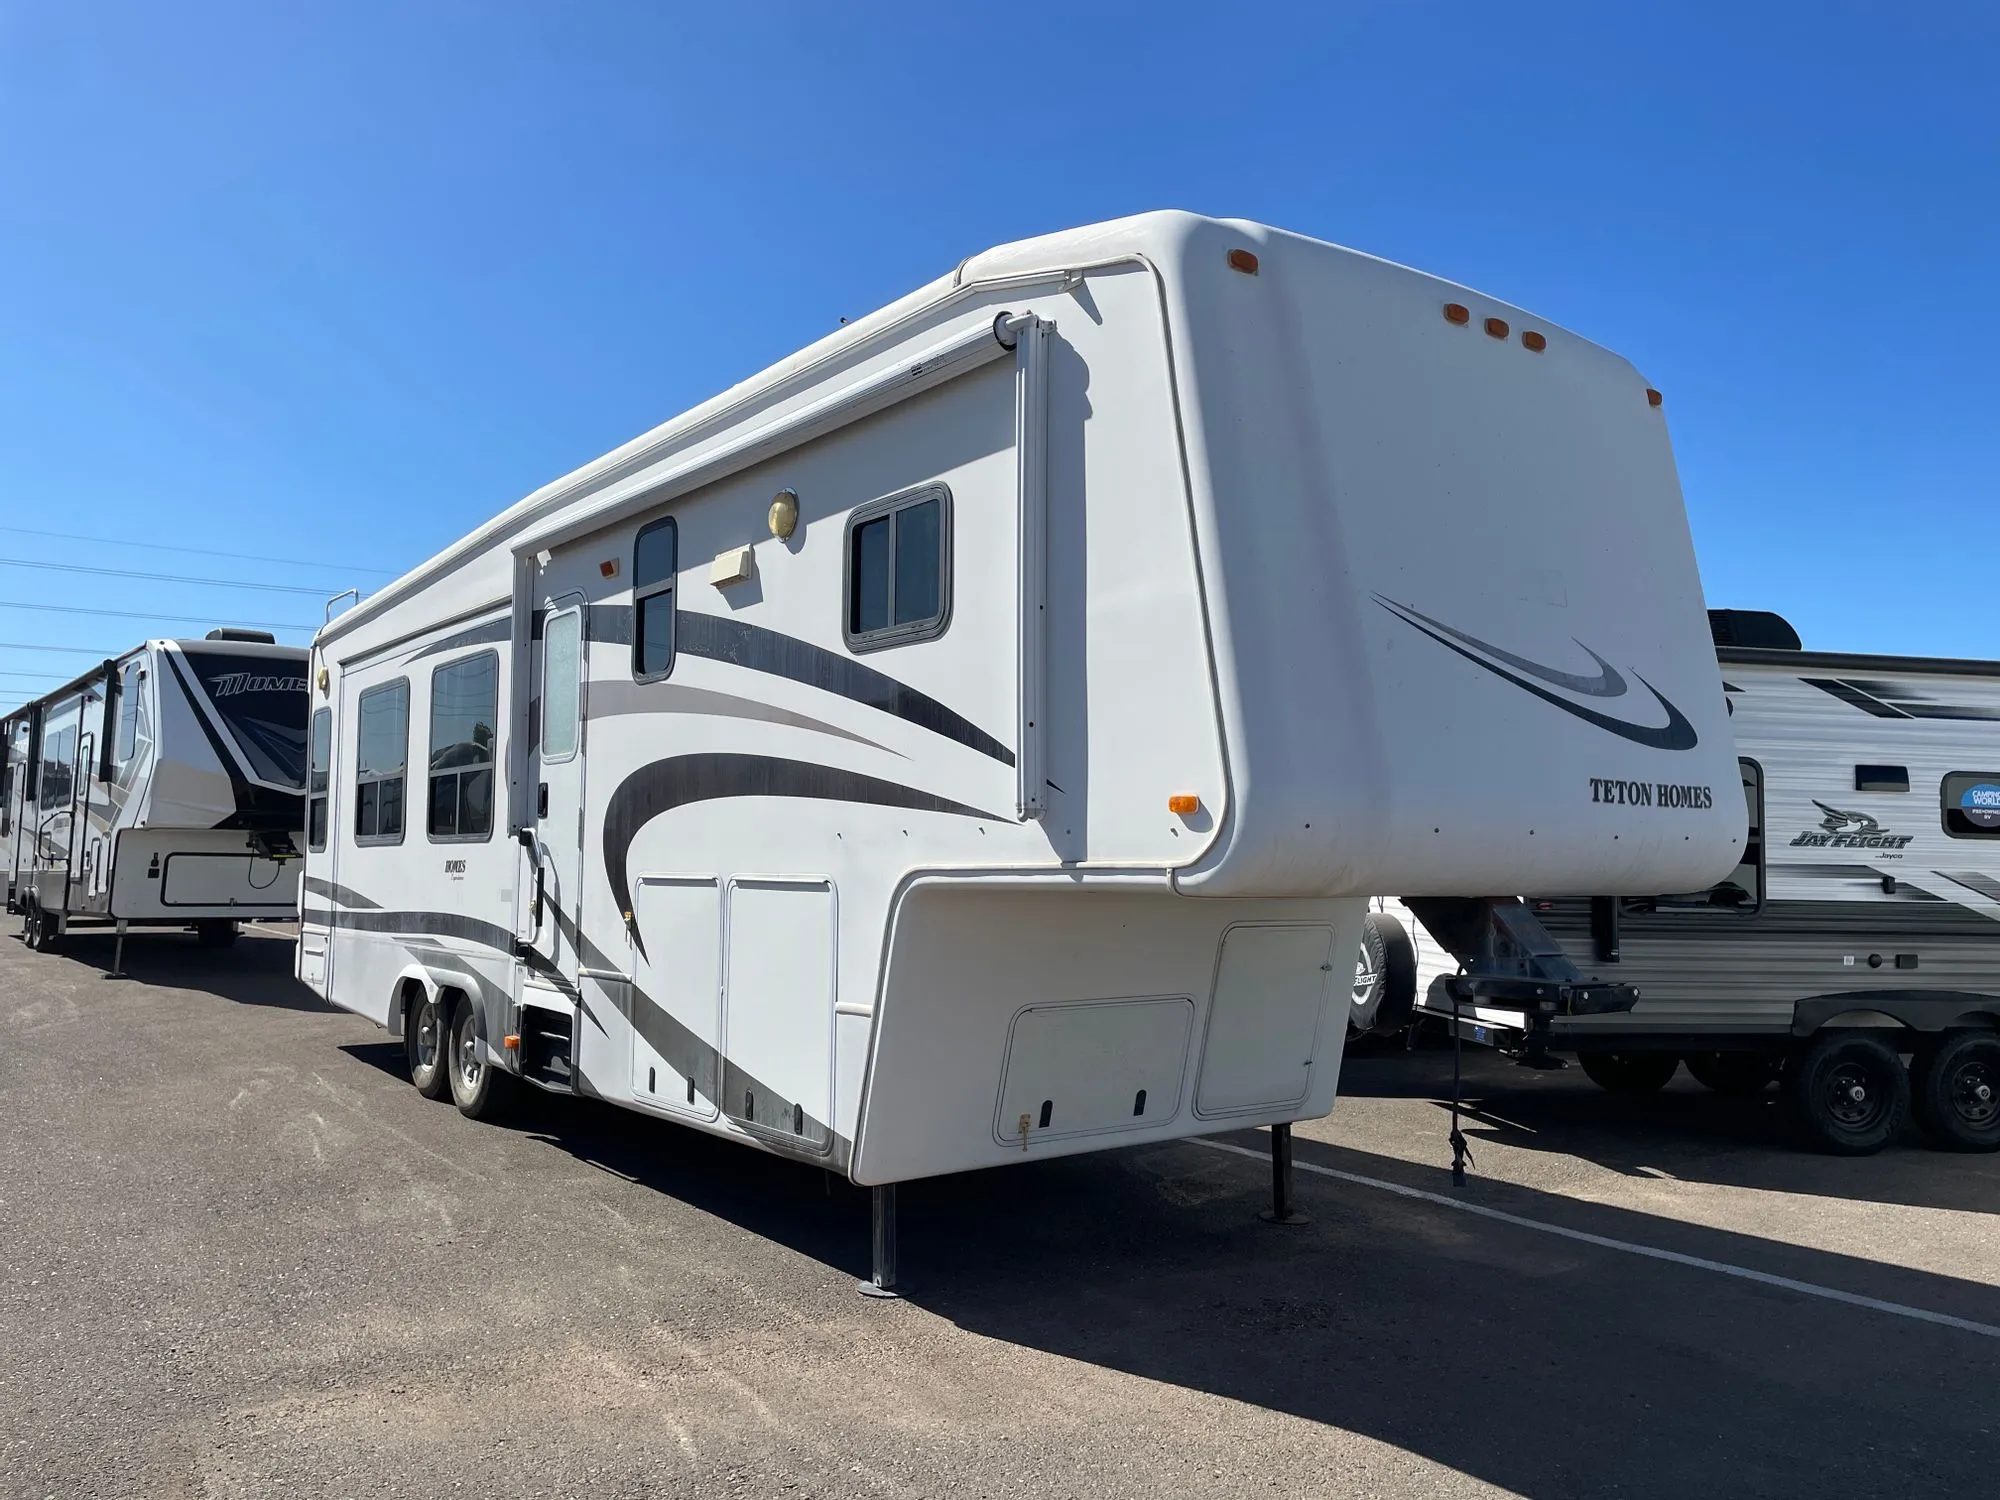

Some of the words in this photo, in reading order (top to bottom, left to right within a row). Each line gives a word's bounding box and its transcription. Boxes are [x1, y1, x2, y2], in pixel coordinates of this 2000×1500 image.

[1590, 778, 1652, 806] TETON
[1656, 784, 1712, 809] HOMES
[1790, 831, 1832, 847] JAY
[1831, 834, 1914, 849] FLIGHT
[1880, 851, 1903, 859] Jayco
